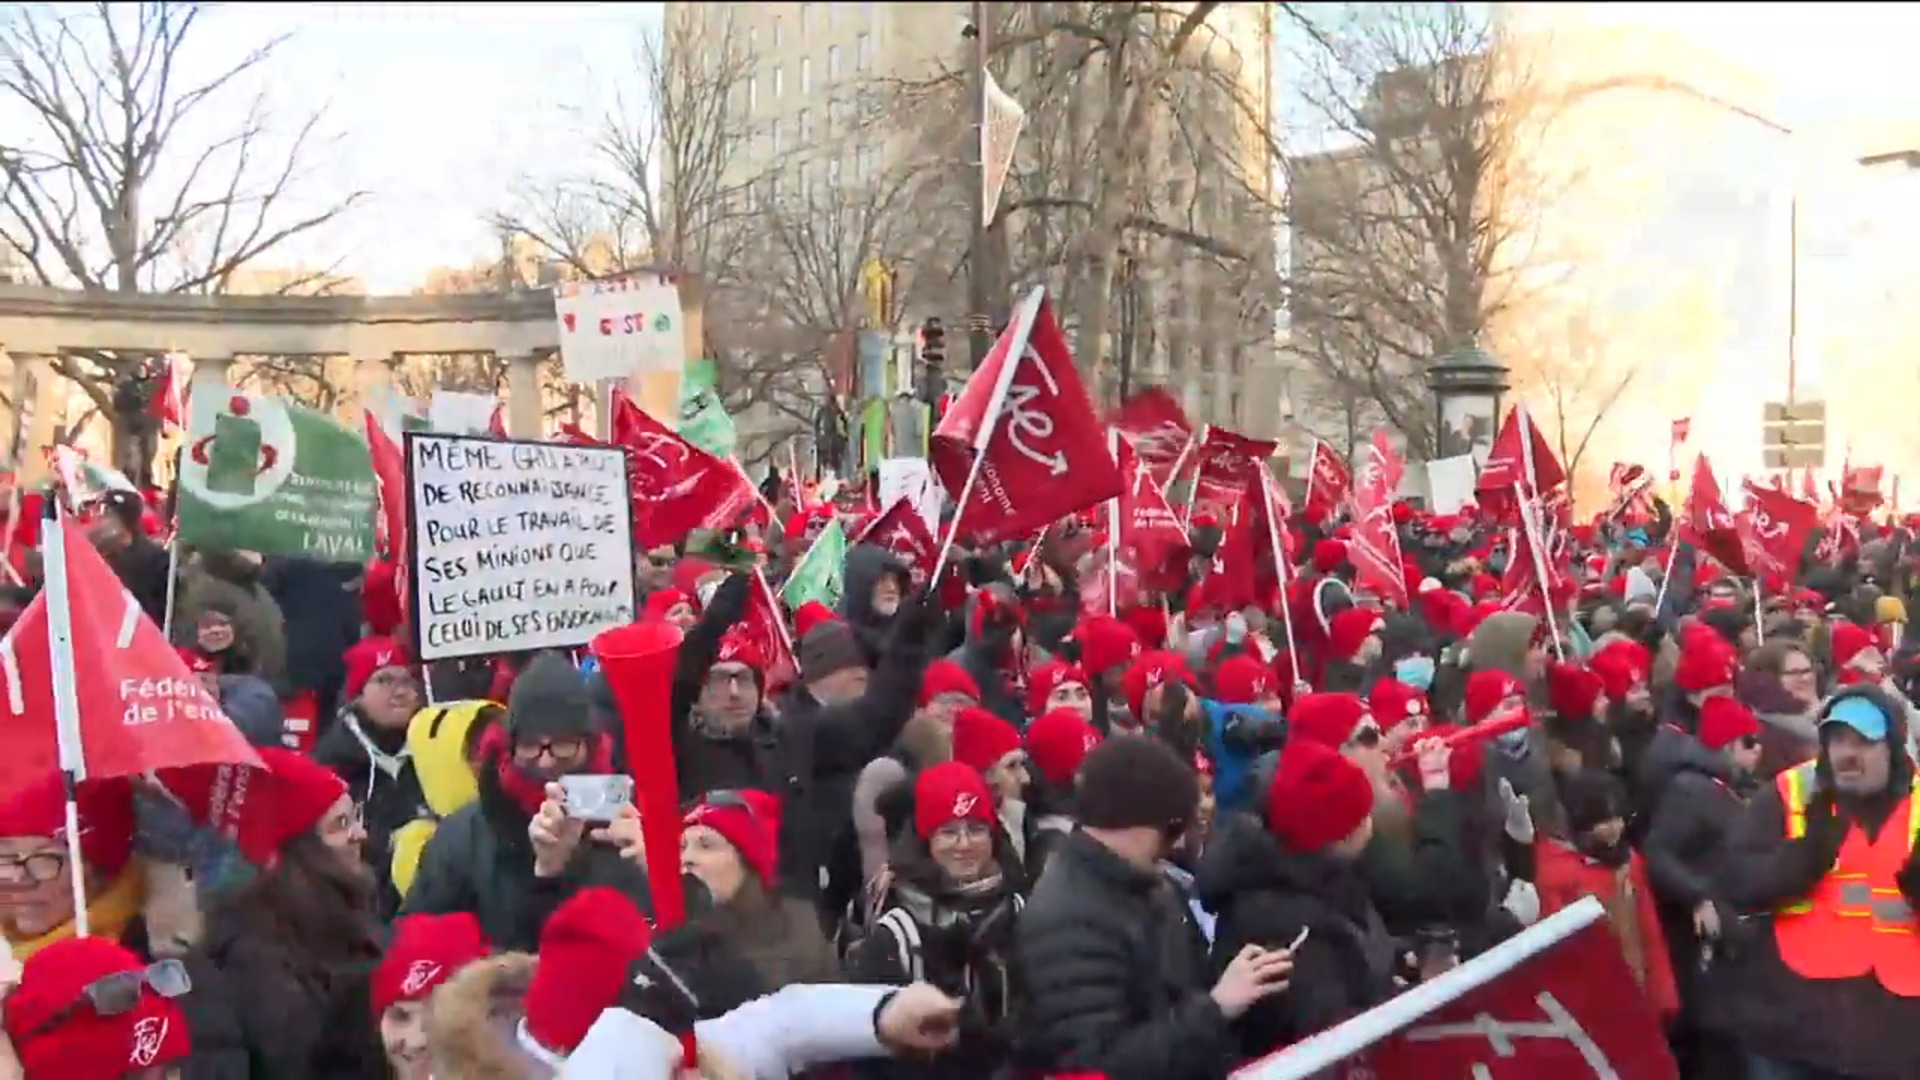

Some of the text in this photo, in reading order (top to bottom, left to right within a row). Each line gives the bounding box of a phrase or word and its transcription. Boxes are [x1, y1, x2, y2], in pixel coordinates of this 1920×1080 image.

[419, 439, 502, 470] MÊME
[423, 483, 450, 507] DE
[427, 518, 479, 546] POUR
[488, 517, 509, 535] LE
[518, 507, 589, 532] TRAVAIL
[425, 556, 467, 583] SES
[560, 543, 597, 563] QUE
[486, 621, 509, 642] DE
[513, 610, 541, 636] SES
[124, 702, 158, 726] de
